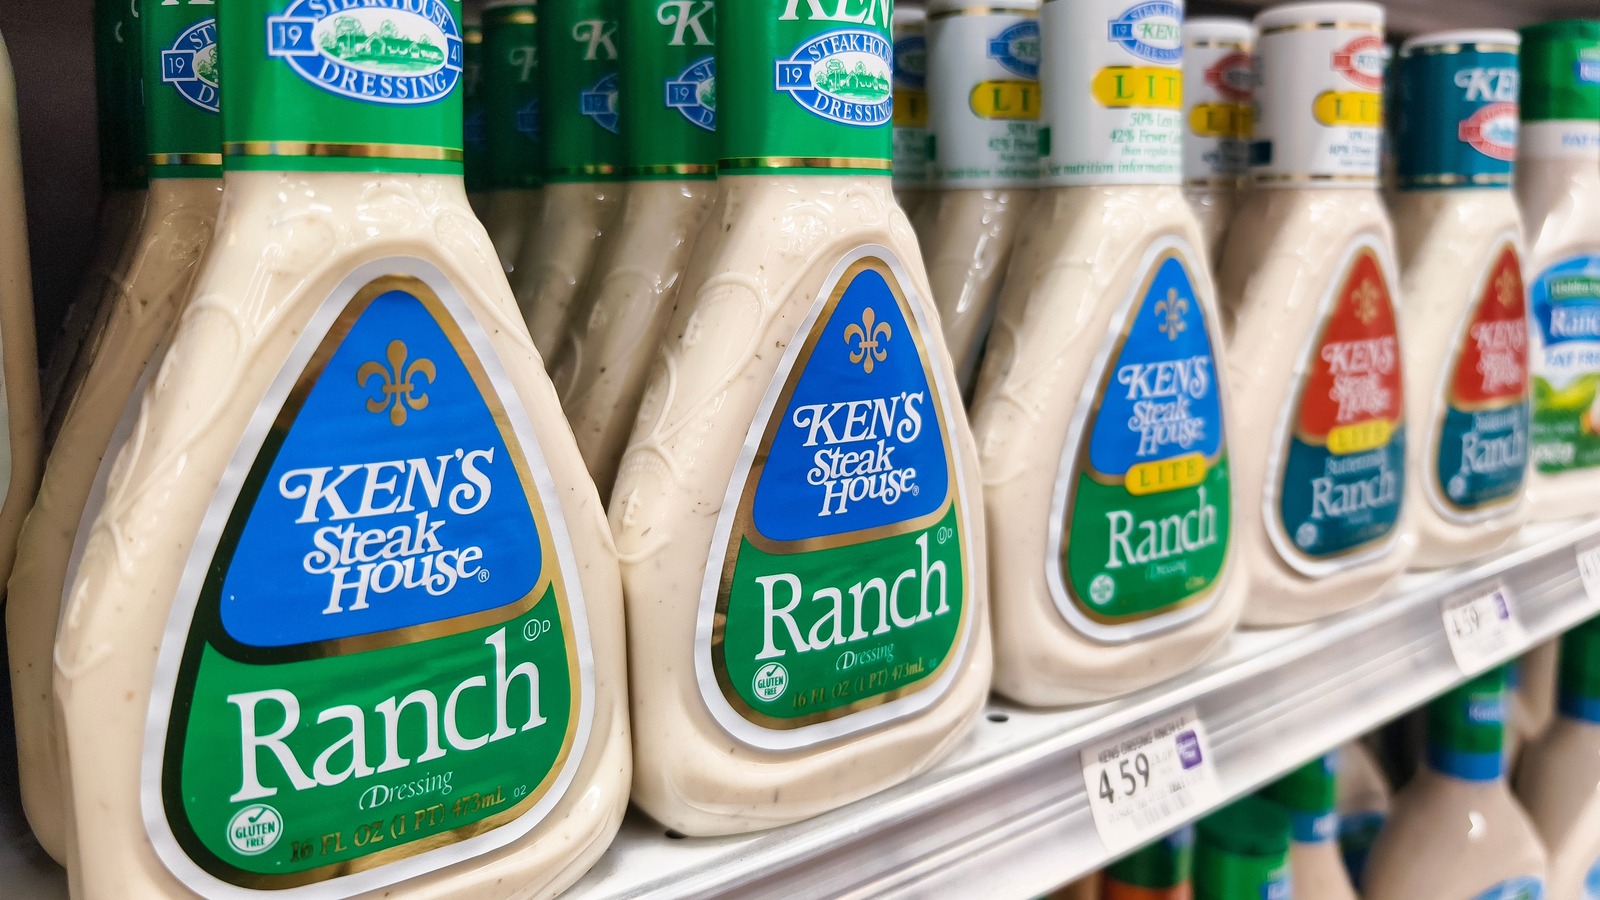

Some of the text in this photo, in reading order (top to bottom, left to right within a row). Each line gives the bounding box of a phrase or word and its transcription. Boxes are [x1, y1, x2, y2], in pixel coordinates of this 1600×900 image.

[278, 25, 303, 49] 19
[808, 34, 860, 61] STEAK
[169, 57, 185, 74] 19
[451, 45, 461, 63] 41
[317, 60, 447, 99] DRESSING
[785, 67, 802, 83] 19
[1114, 75, 1178, 99] LIT
[674, 87, 690, 101] 19
[813, 92, 891, 122] DRESSING
[1117, 355, 1211, 400] KEN'S
[792, 391, 925, 447] KEN'S
[1128, 394, 1191, 432] Steak
[806, 439, 896, 486] Steak
[1139, 457, 1198, 488] LITE
[279, 446, 495, 524] KEN'S
[1310, 463, 1395, 519] Ranch
[1104, 484, 1218, 569] Ranch
[303, 511, 447, 574] Steak
[754, 531, 950, 661] Ranch
[835, 643, 895, 671] Dressing
[757, 675, 784, 689] GLUTEN
[764, 687, 777, 696] FREE
[227, 627, 547, 803] Ranch
[793, 692, 806, 708] 16
[358, 770, 453, 811] Dressing
[513, 784, 527, 798] 02
[1099, 752, 1150, 804] 4.59
[235, 820, 275, 839] GLUTEN
[290, 840, 314, 862] 16
[320, 834, 347, 855] FL
[353, 820, 385, 847] OZ
[413, 803, 446, 832] PT)
[451, 785, 506, 817] 473mL
[246, 836, 265, 848] FREE
